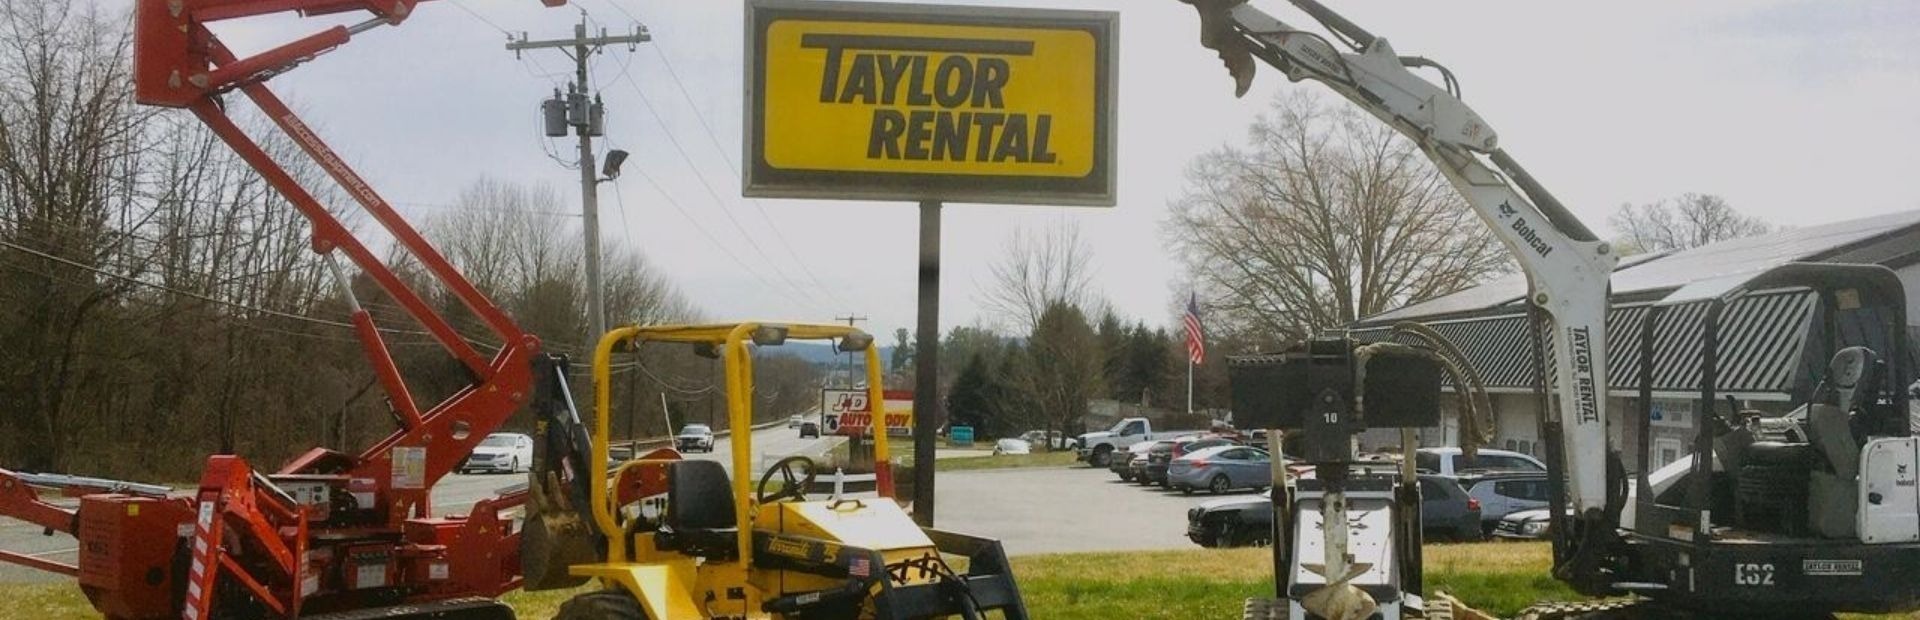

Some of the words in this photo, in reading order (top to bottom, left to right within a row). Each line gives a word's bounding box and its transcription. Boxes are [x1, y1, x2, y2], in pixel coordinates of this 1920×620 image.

[801, 34, 1035, 109] TAYLOR
[866, 109, 1057, 164] RENTAL
[1511, 216, 1553, 258] Bobcat
[1573, 325, 1591, 373] TAYLOR
[840, 412, 872, 426] AUTO
[883, 413, 911, 428] ODY
[1323, 412, 1338, 424] 10
[1579, 377, 1598, 424] RENTAL
